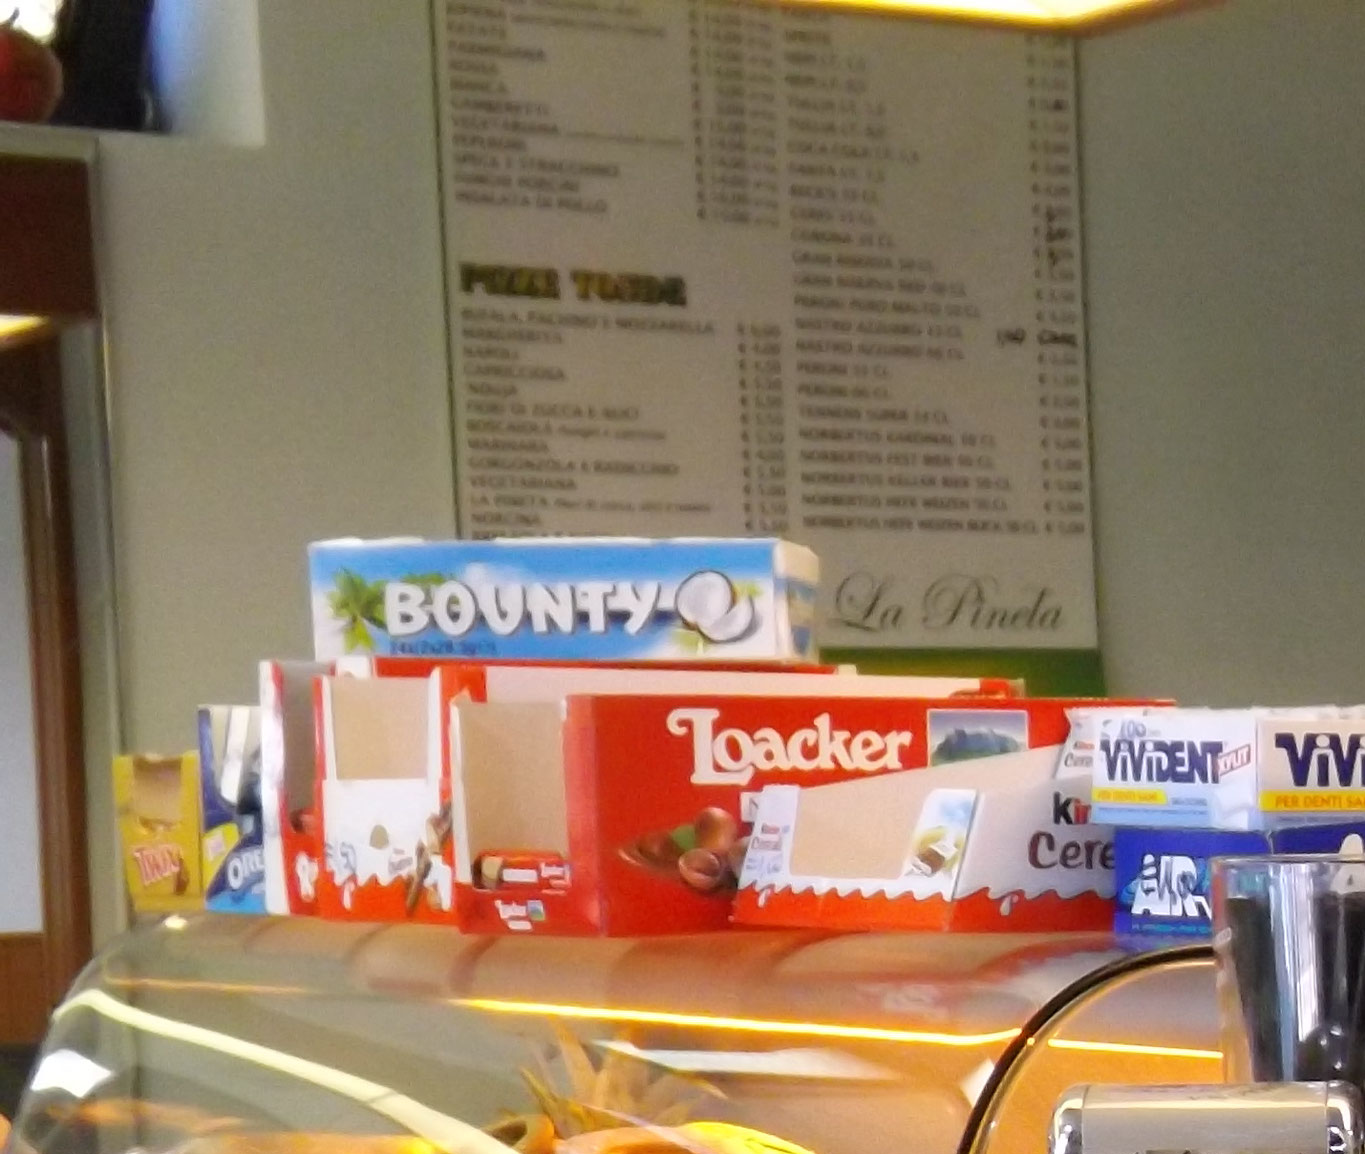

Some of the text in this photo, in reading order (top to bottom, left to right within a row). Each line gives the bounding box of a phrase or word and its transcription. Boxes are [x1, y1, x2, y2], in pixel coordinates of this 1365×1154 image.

[385, 580, 659, 636] BOUNTY
[667, 708, 911, 785] Loacker
[1275, 795, 1300, 808] PER
[1304, 795, 1341, 808] DENTI
